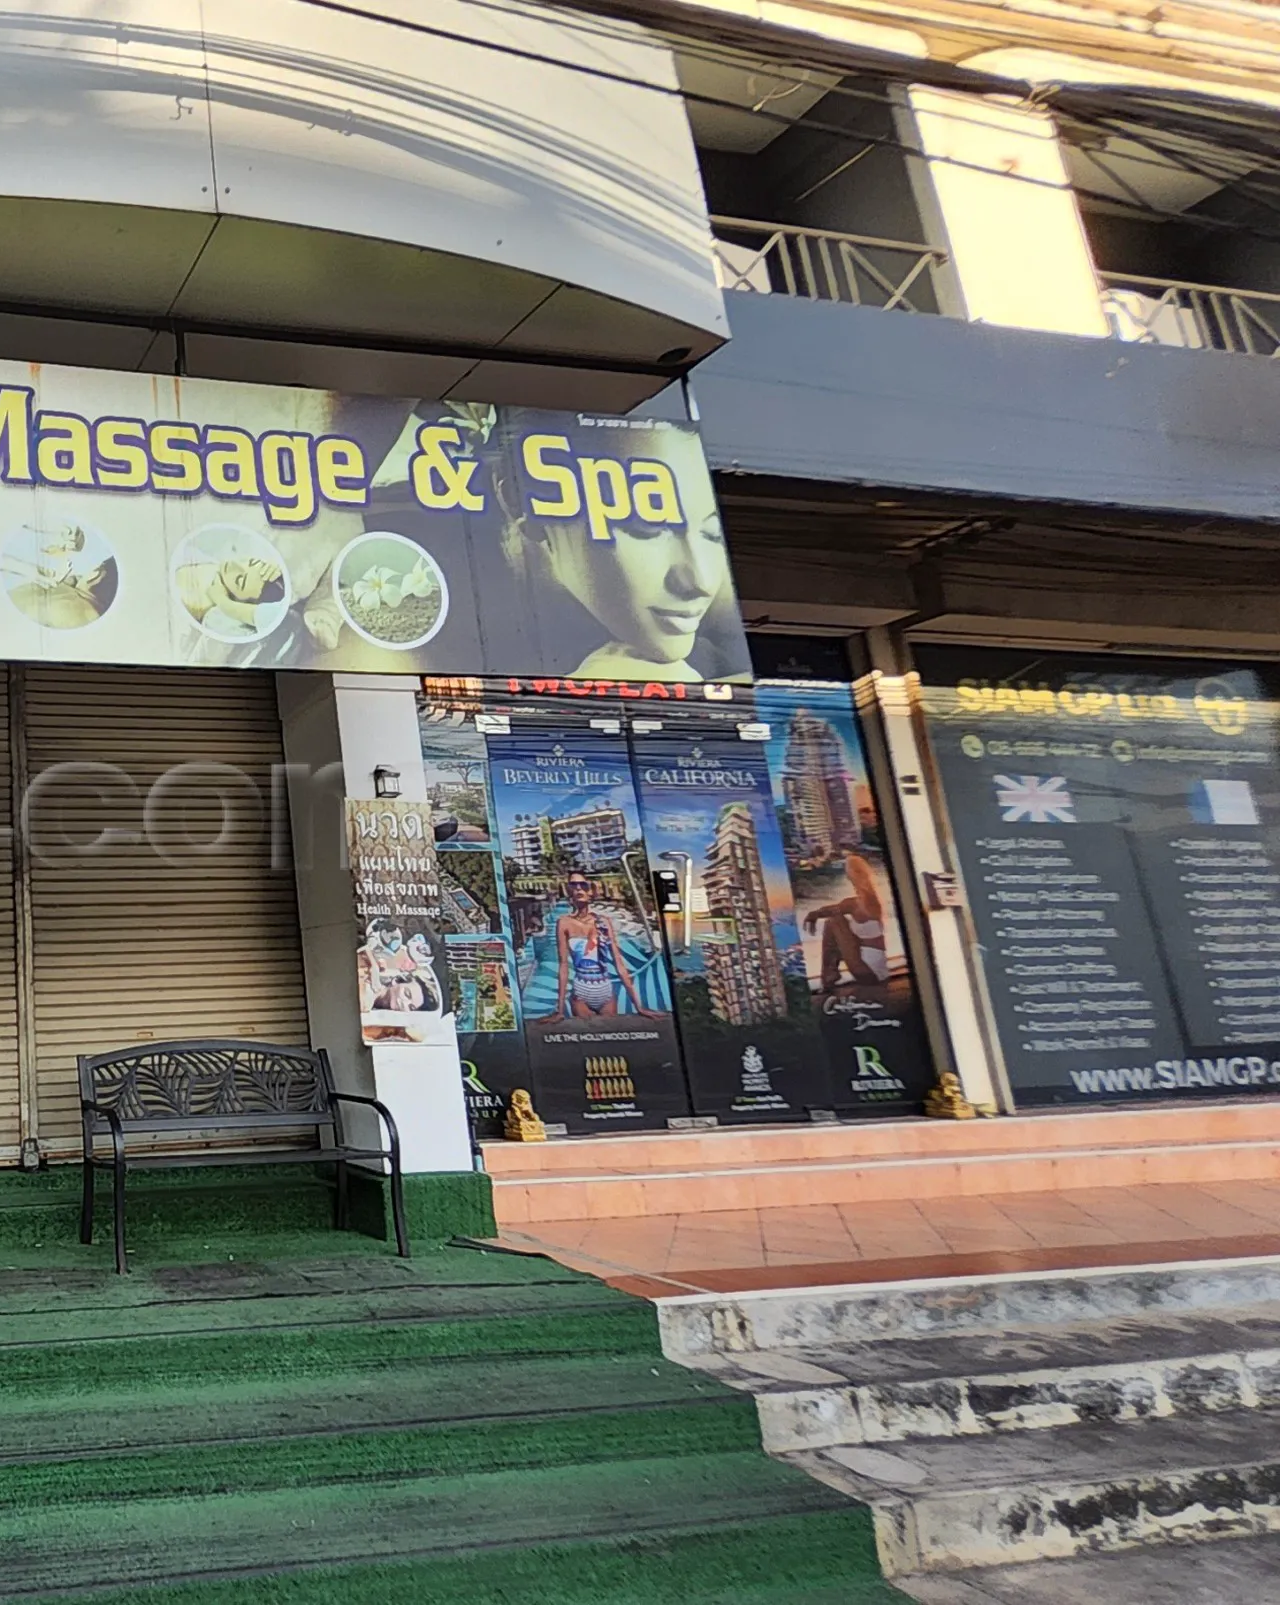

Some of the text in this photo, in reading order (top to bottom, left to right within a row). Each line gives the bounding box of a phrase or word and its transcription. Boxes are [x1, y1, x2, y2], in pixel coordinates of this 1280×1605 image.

[409, 422, 486, 512] &
[520, 431, 687, 543] Spa
[535, 757, 585, 768] RIVIERA
[503, 768, 623, 786] BEVERLY HILLS
[644, 768, 758, 790] CALIFORNIA
[356, 811, 424, 840] นวด
[359, 845, 431, 872] แผนไทย
[356, 903, 391, 916] Health
[465, 1095, 504, 1108] IERA
